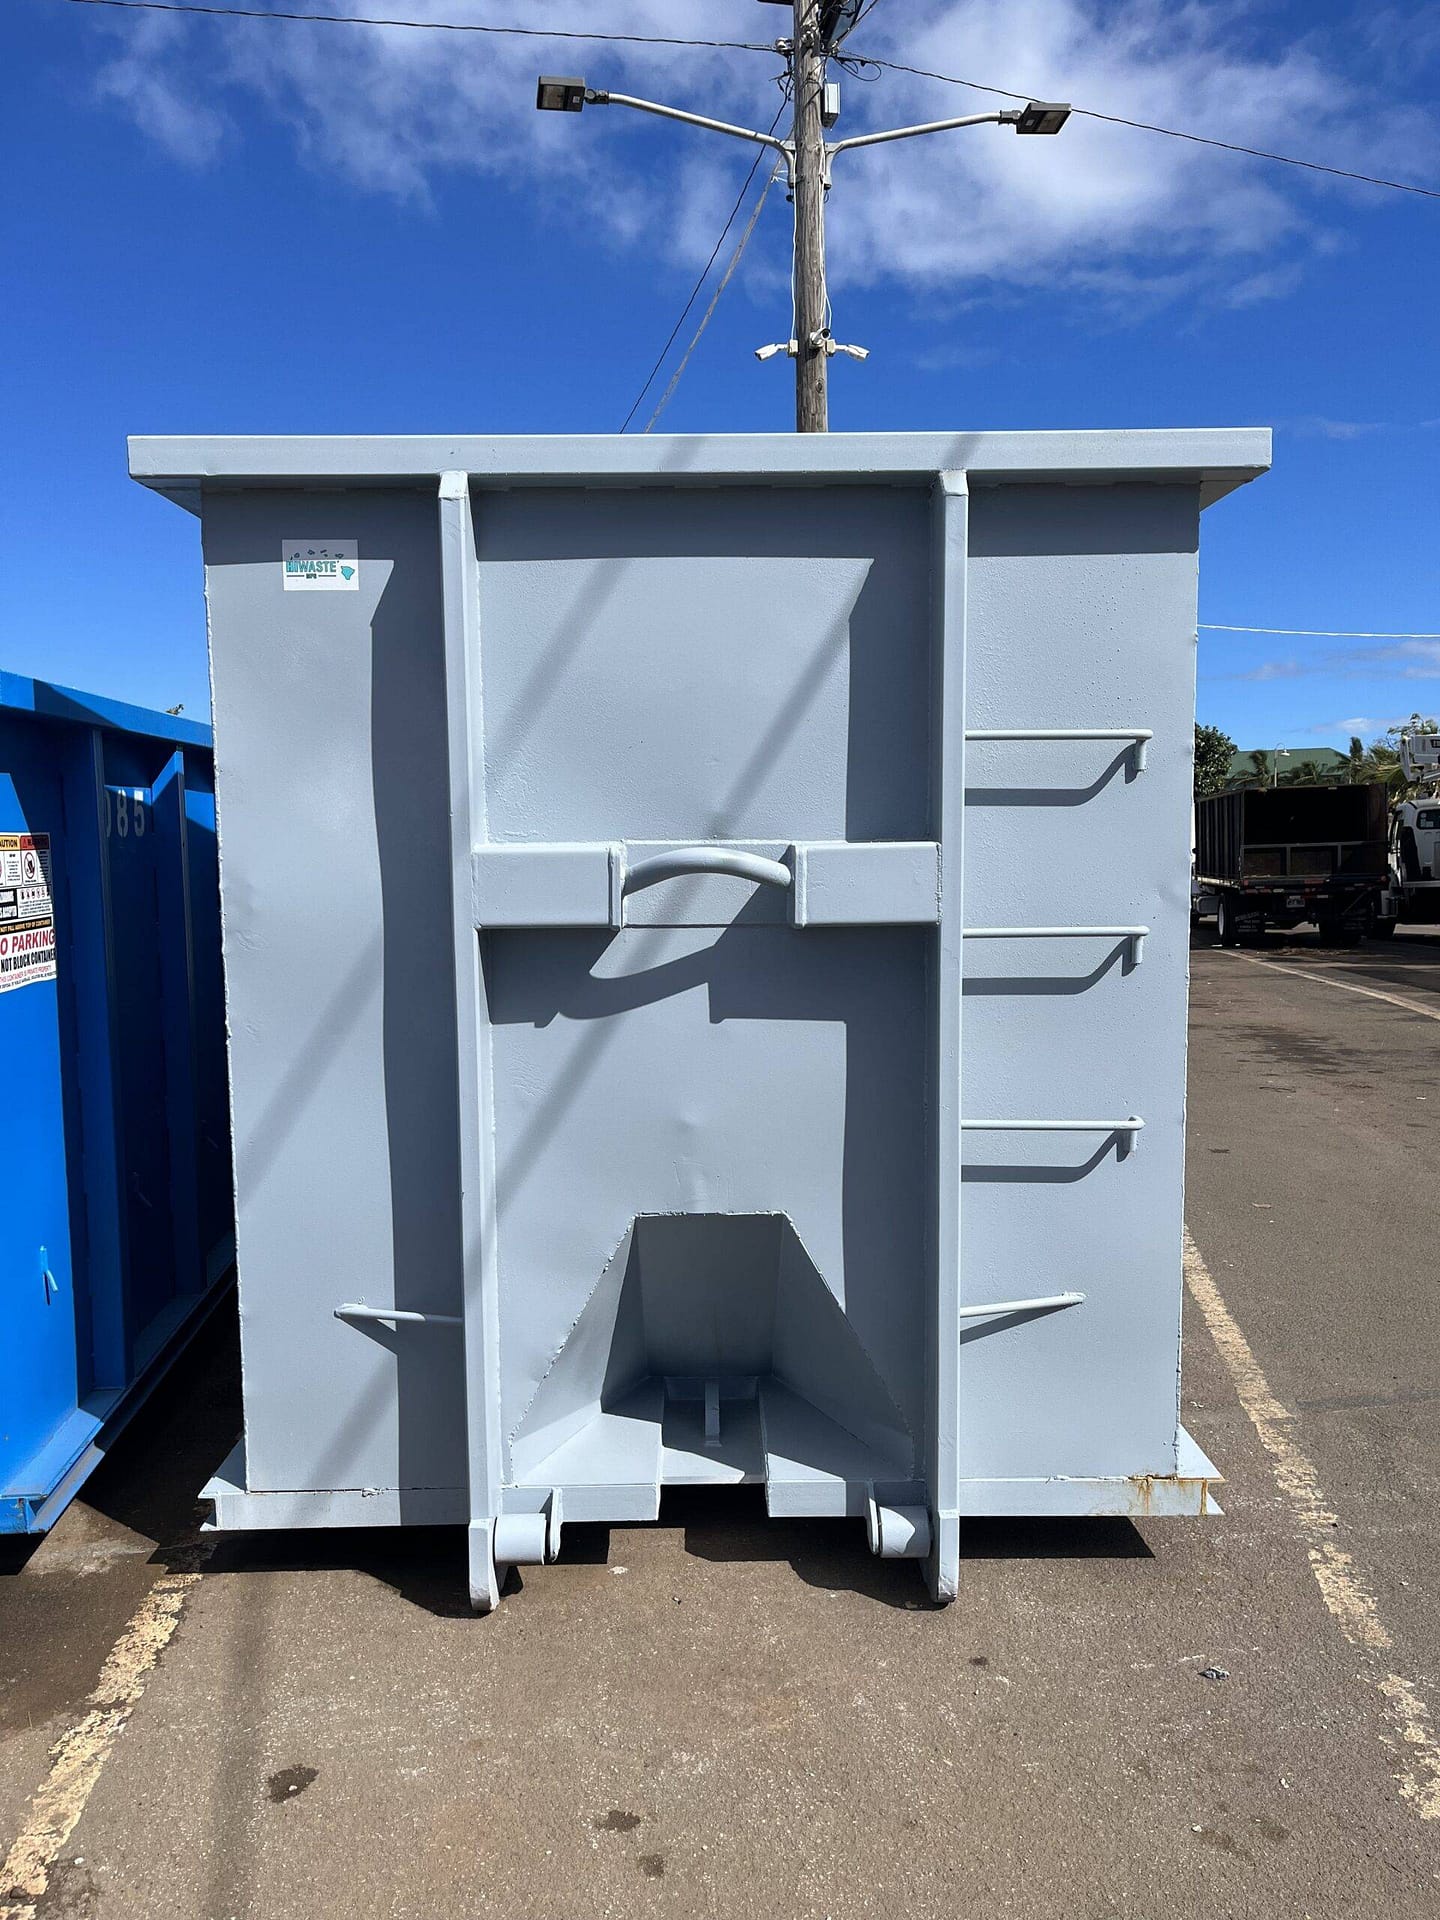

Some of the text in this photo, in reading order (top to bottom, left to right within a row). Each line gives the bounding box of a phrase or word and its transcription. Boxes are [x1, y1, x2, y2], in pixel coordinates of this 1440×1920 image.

[0, 839, 17, 848] AUTION
[0, 928, 56, 955] O PARKING
[1, 948, 56, 973] NOT BLOCK CONTAINER
